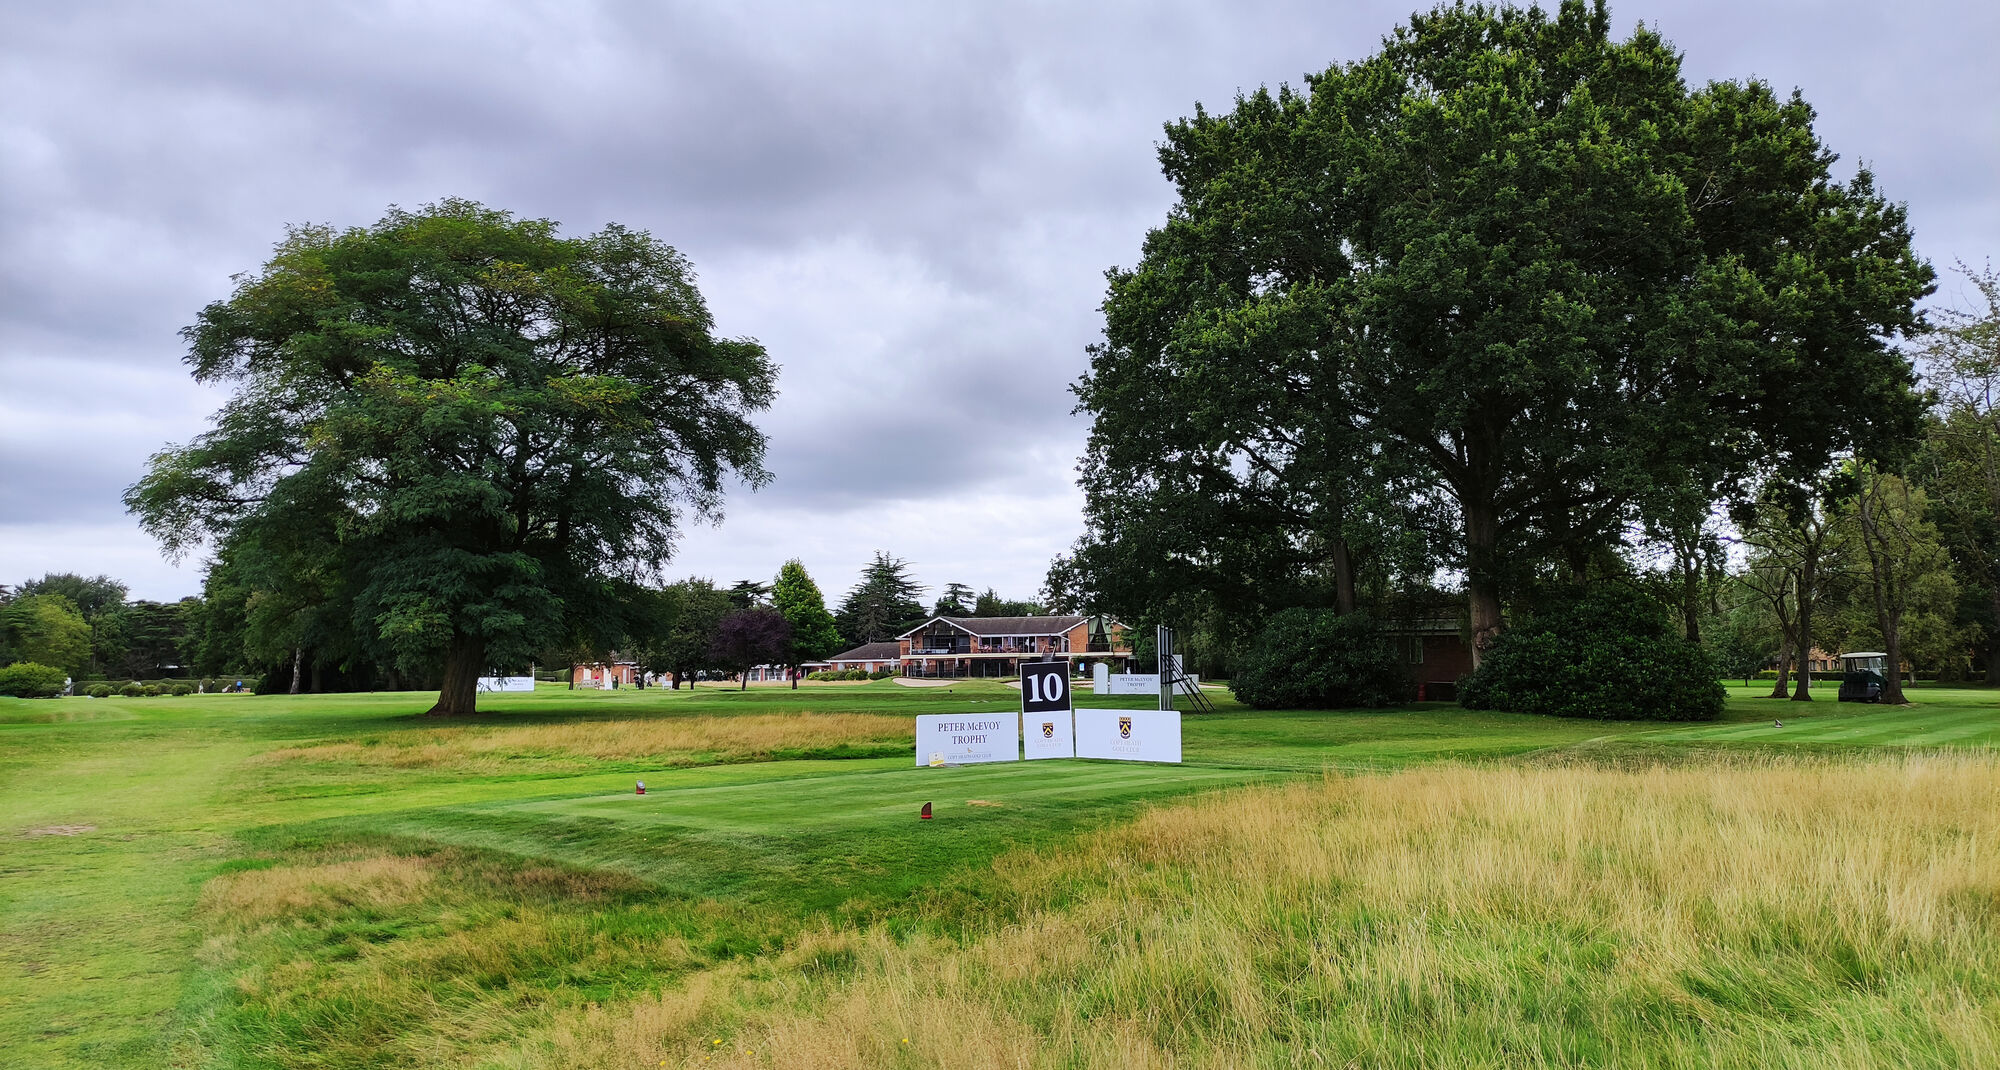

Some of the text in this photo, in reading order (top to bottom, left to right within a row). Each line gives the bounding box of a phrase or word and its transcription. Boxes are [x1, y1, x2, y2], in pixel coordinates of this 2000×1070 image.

[1027, 672, 1063, 702] 10
[938, 721, 1001, 732] PETER McEVOY
[952, 734, 988, 745] TROPHY
